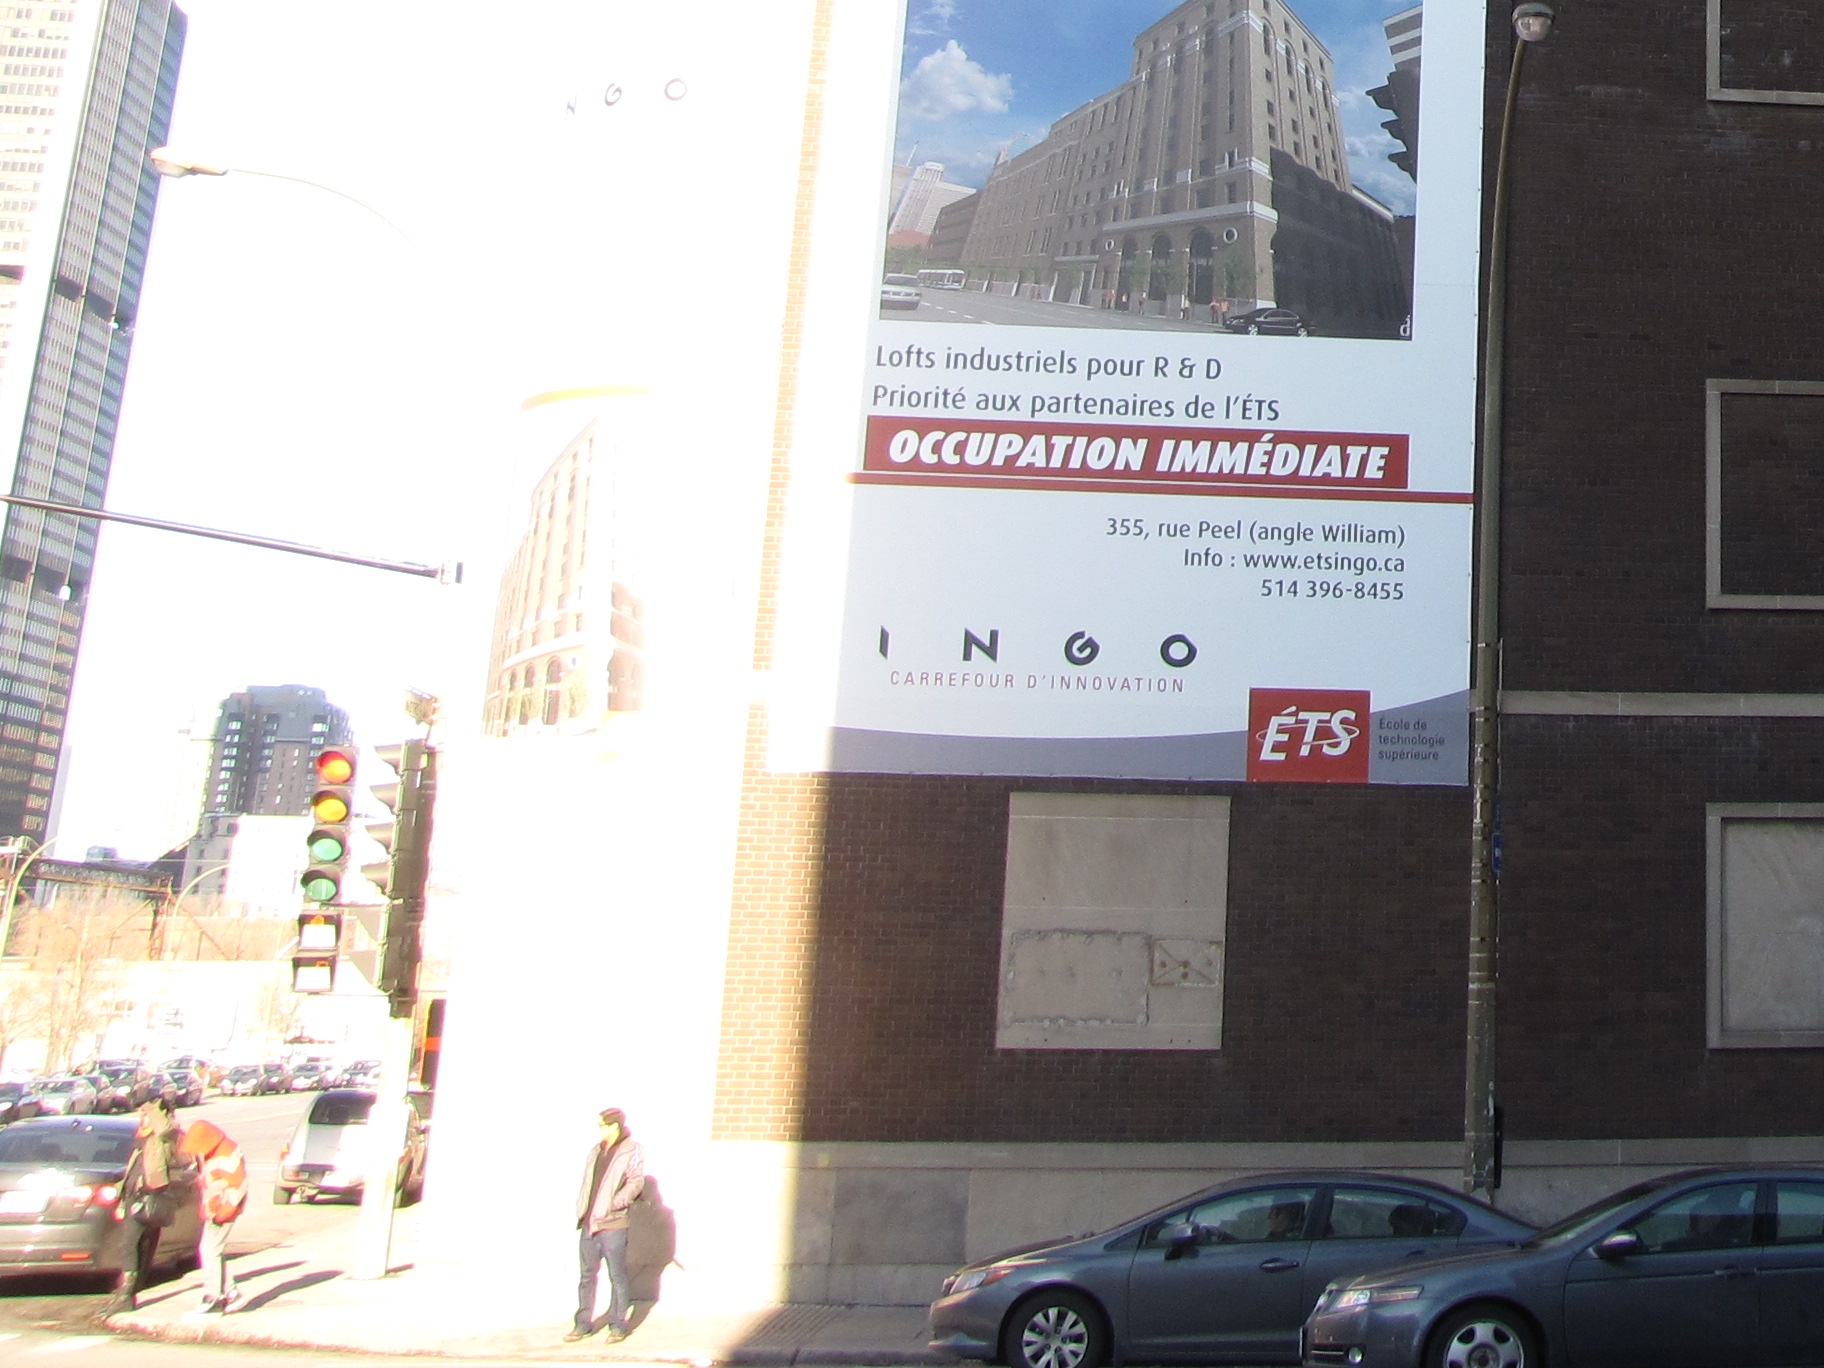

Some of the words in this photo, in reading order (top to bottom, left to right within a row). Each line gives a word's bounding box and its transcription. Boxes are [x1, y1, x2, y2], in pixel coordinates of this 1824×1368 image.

[875, 345, 936, 369] Lofts
[945, 347, 1077, 374] industriels
[1087, 356, 1145, 380] pour
[1154, 357, 1168, 377] R
[1178, 358, 1196, 379] &
[1205, 358, 1222, 380] D
[872, 384, 966, 410] Priorité
[975, 393, 1021, 412] aux
[1030, 392, 1175, 418] partenaires
[1184, 395, 1215, 419] de
[888, 429, 1148, 471] OCCUPATION
[1156, 433, 1390, 479] IMMÉDIATE
[1106, 518, 1150, 541] 355,
[1158, 522, 1191, 537] rue
[1198, 520, 1242, 540] Peel
[1249, 520, 1314, 546] (angle
[1322, 524, 1406, 549] William)
[1184, 547, 1223, 568] Info
[1243, 552, 1405, 576] www.etsingo.ca
[1260, 579, 1298, 598] 514
[1305, 580, 1404, 600] 396-8455
[890, 670, 1015, 689] CARREFOUR
[1027, 674, 1185, 693] D'INNOVATION
[1258, 705, 1357, 761] ÉTS
[1379, 715, 1410, 730] École
[1413, 718, 1427, 730] de
[1378, 748, 1439, 762] supérieure
[1379, 734, 1445, 748] technologie
